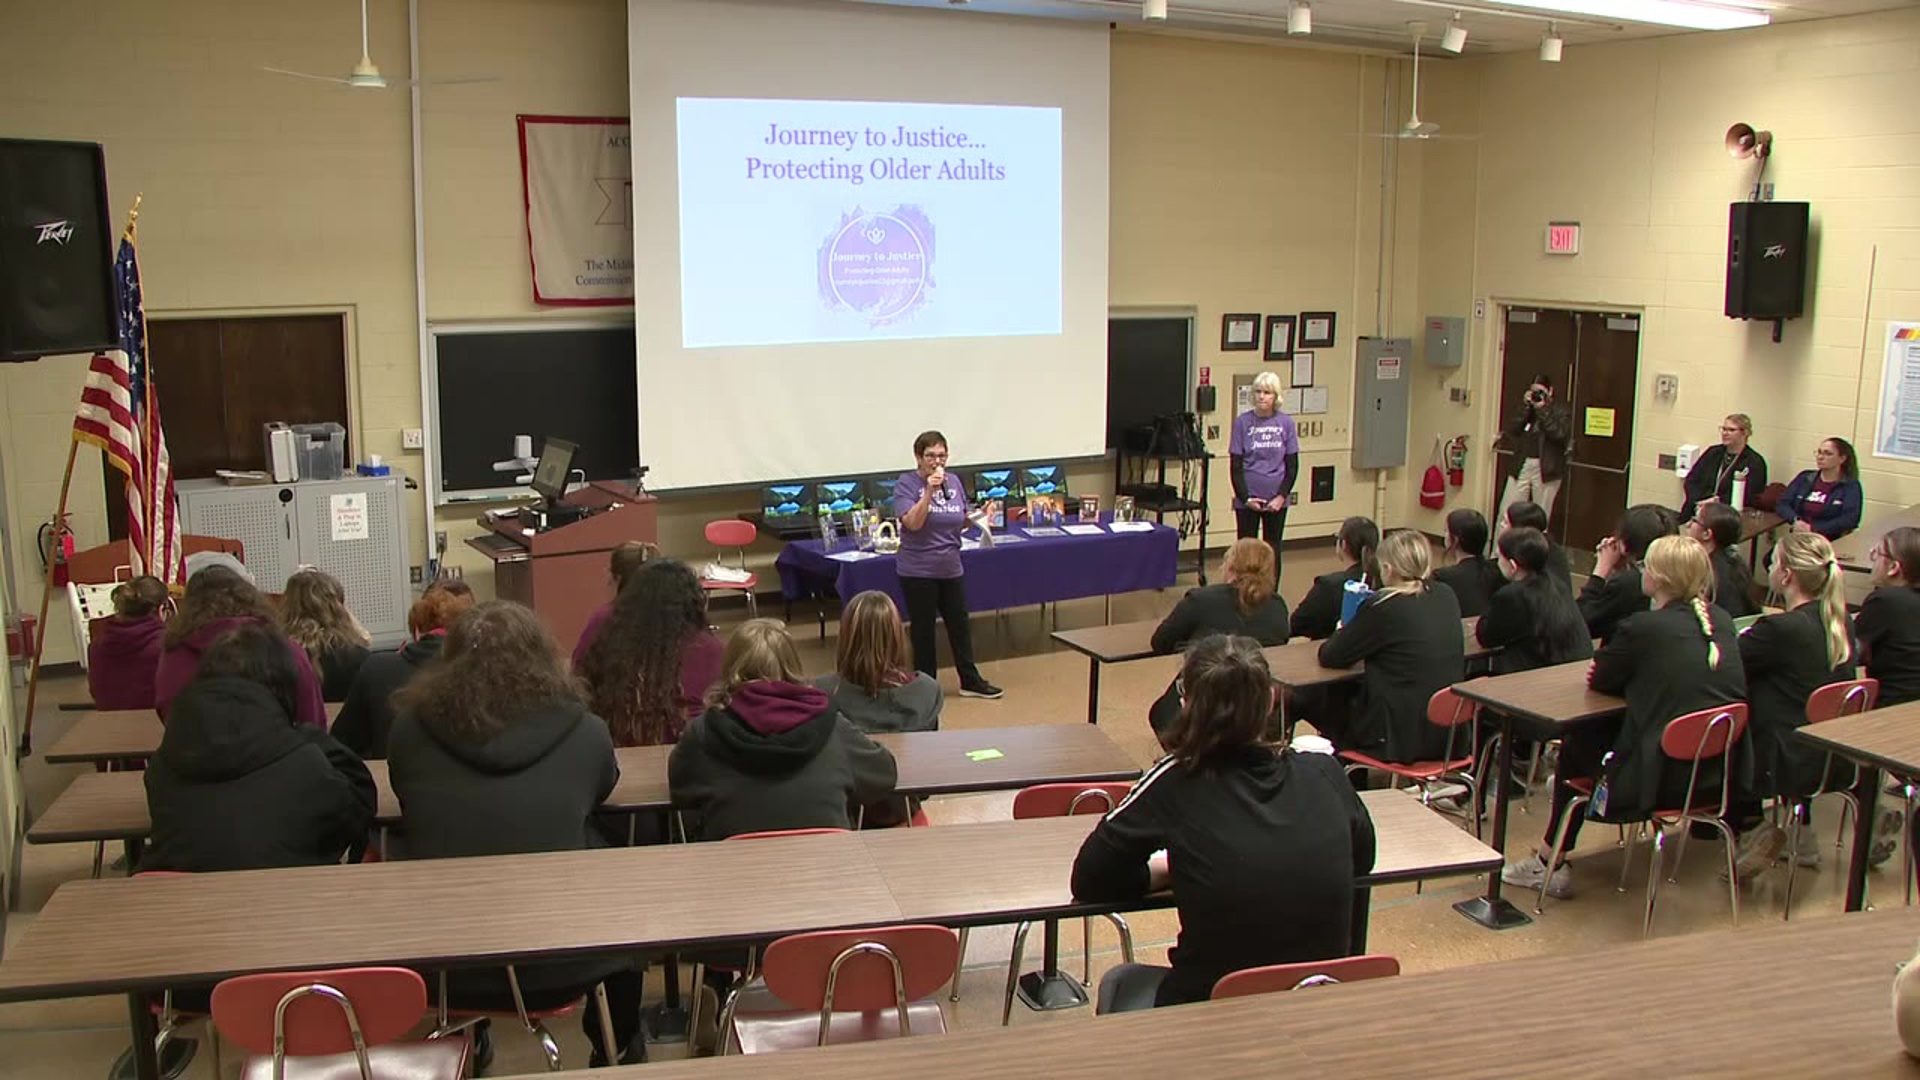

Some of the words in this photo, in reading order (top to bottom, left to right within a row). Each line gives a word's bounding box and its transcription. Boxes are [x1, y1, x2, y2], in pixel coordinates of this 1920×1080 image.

[764, 123, 859, 151] Journey
[865, 127, 886, 147] to
[891, 126, 986, 148] Justice...
[745, 157, 864, 185] Protecting
[870, 157, 931, 180] Older
[937, 158, 1006, 181] Adults
[1551, 226, 1572, 250] EXIT
[584, 259, 604, 270] The
